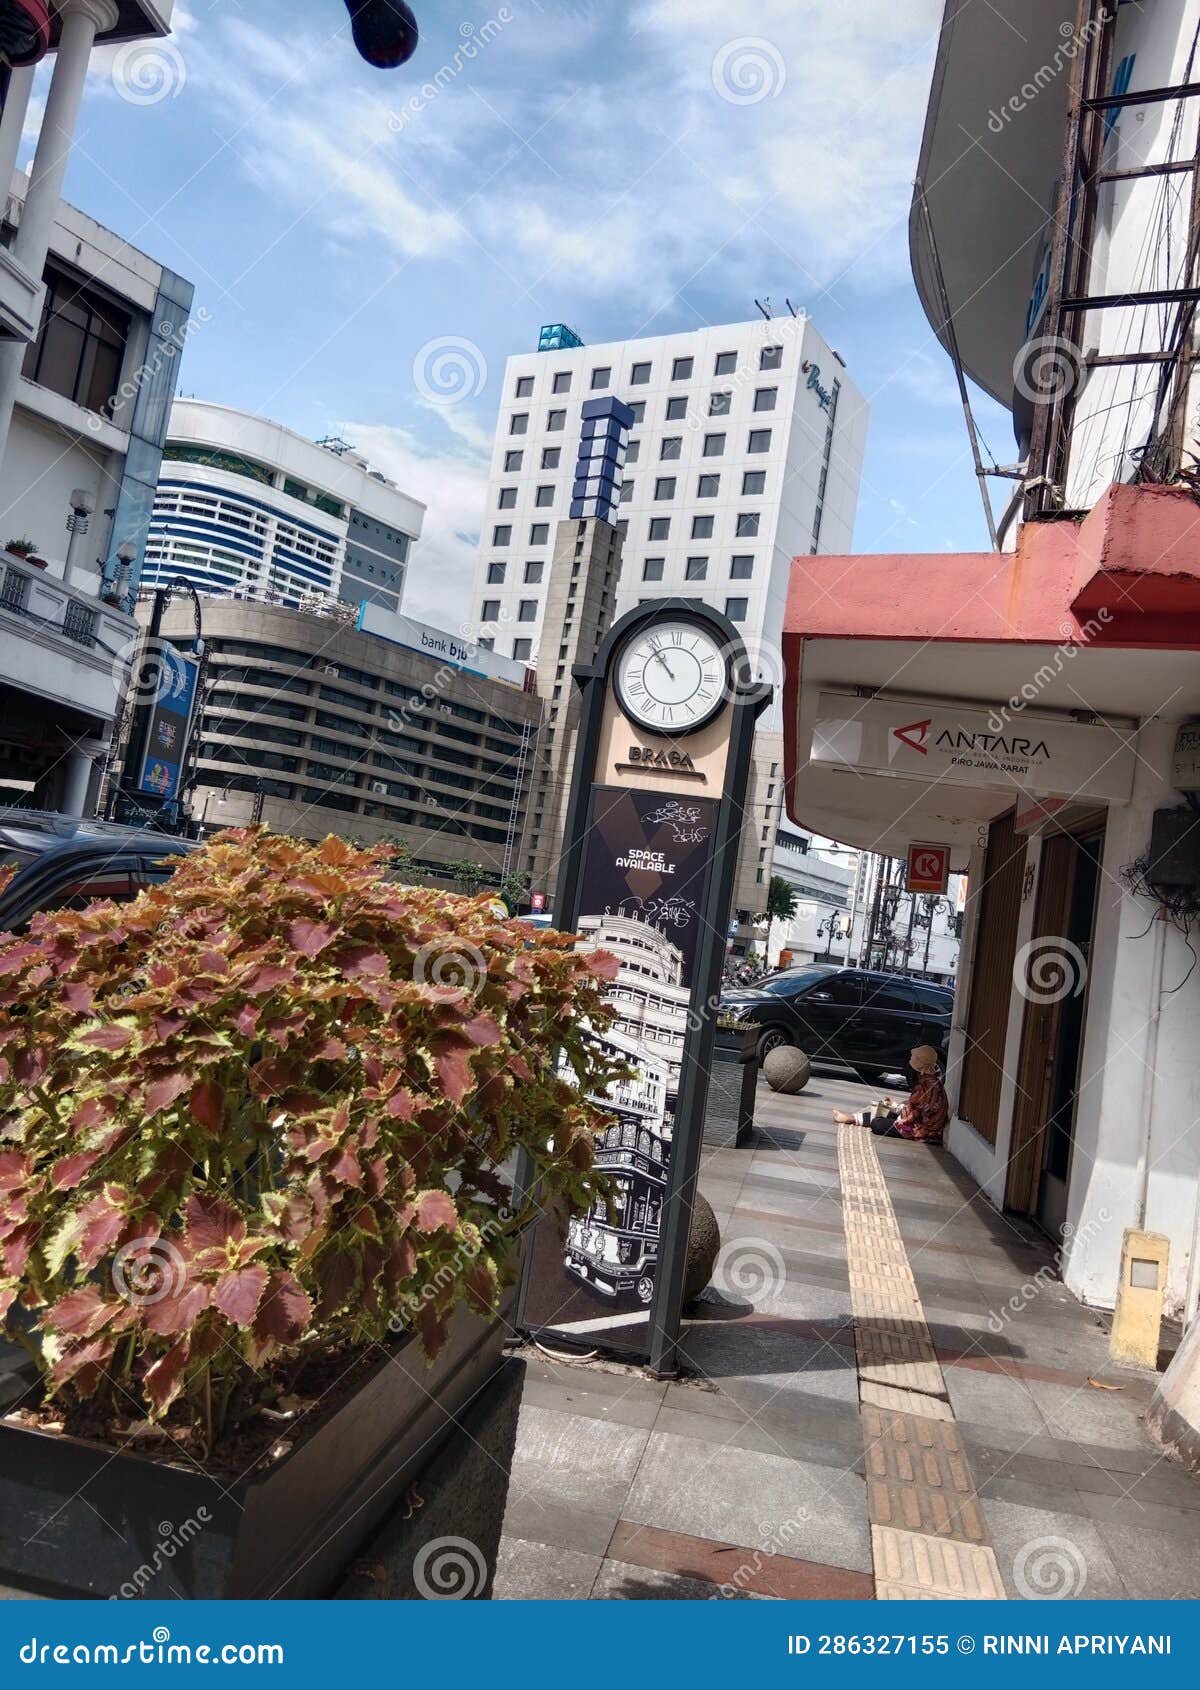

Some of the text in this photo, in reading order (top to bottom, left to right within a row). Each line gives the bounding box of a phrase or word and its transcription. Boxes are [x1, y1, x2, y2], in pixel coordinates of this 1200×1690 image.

[421, 632, 468, 660] bank bjb
[936, 729, 1050, 759] ANTARA
[628, 746, 695, 769] BRAGA
[951, 757, 1030, 775] BIRO JAWA BARAT
[615, 857, 676, 874] AVAILABLE
[628, 849, 665, 863] SPACE
